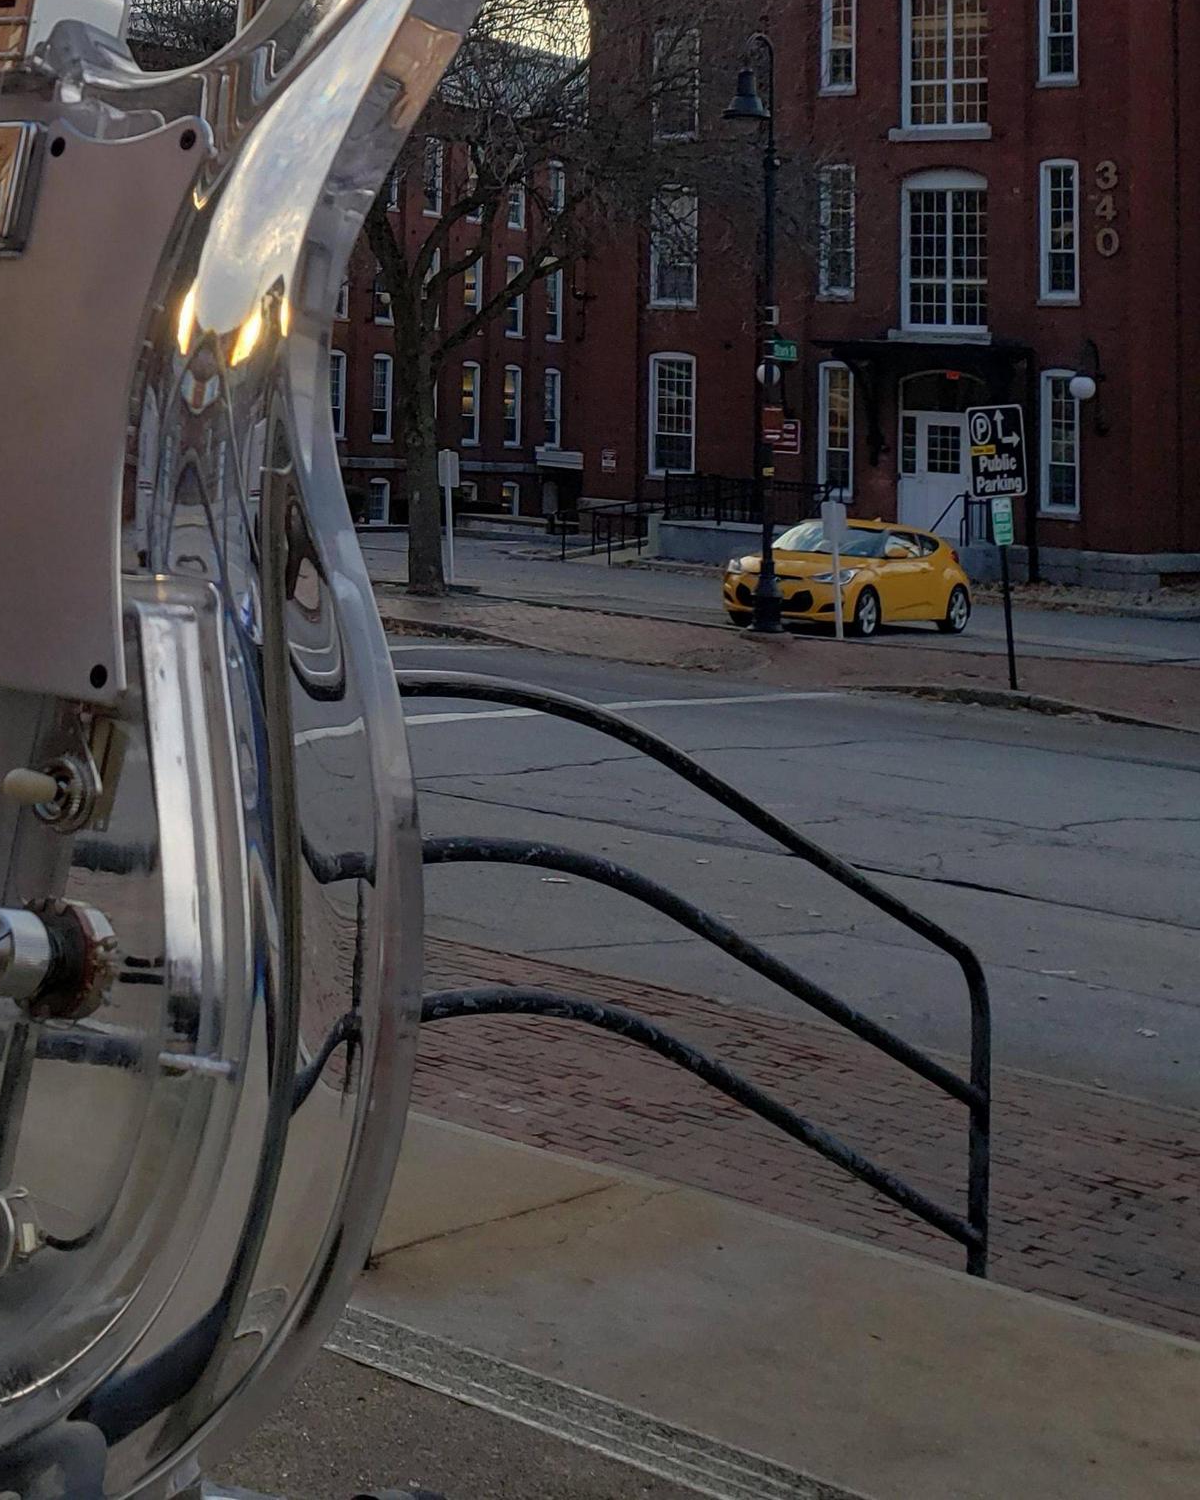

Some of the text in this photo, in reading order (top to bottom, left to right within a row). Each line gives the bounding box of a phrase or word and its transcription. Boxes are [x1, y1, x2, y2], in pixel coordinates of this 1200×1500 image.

[1095, 160, 1120, 257] 340
[975, 418, 988, 440] P
[979, 453, 1017, 472] Public
[975, 473, 1023, 494] Parking
